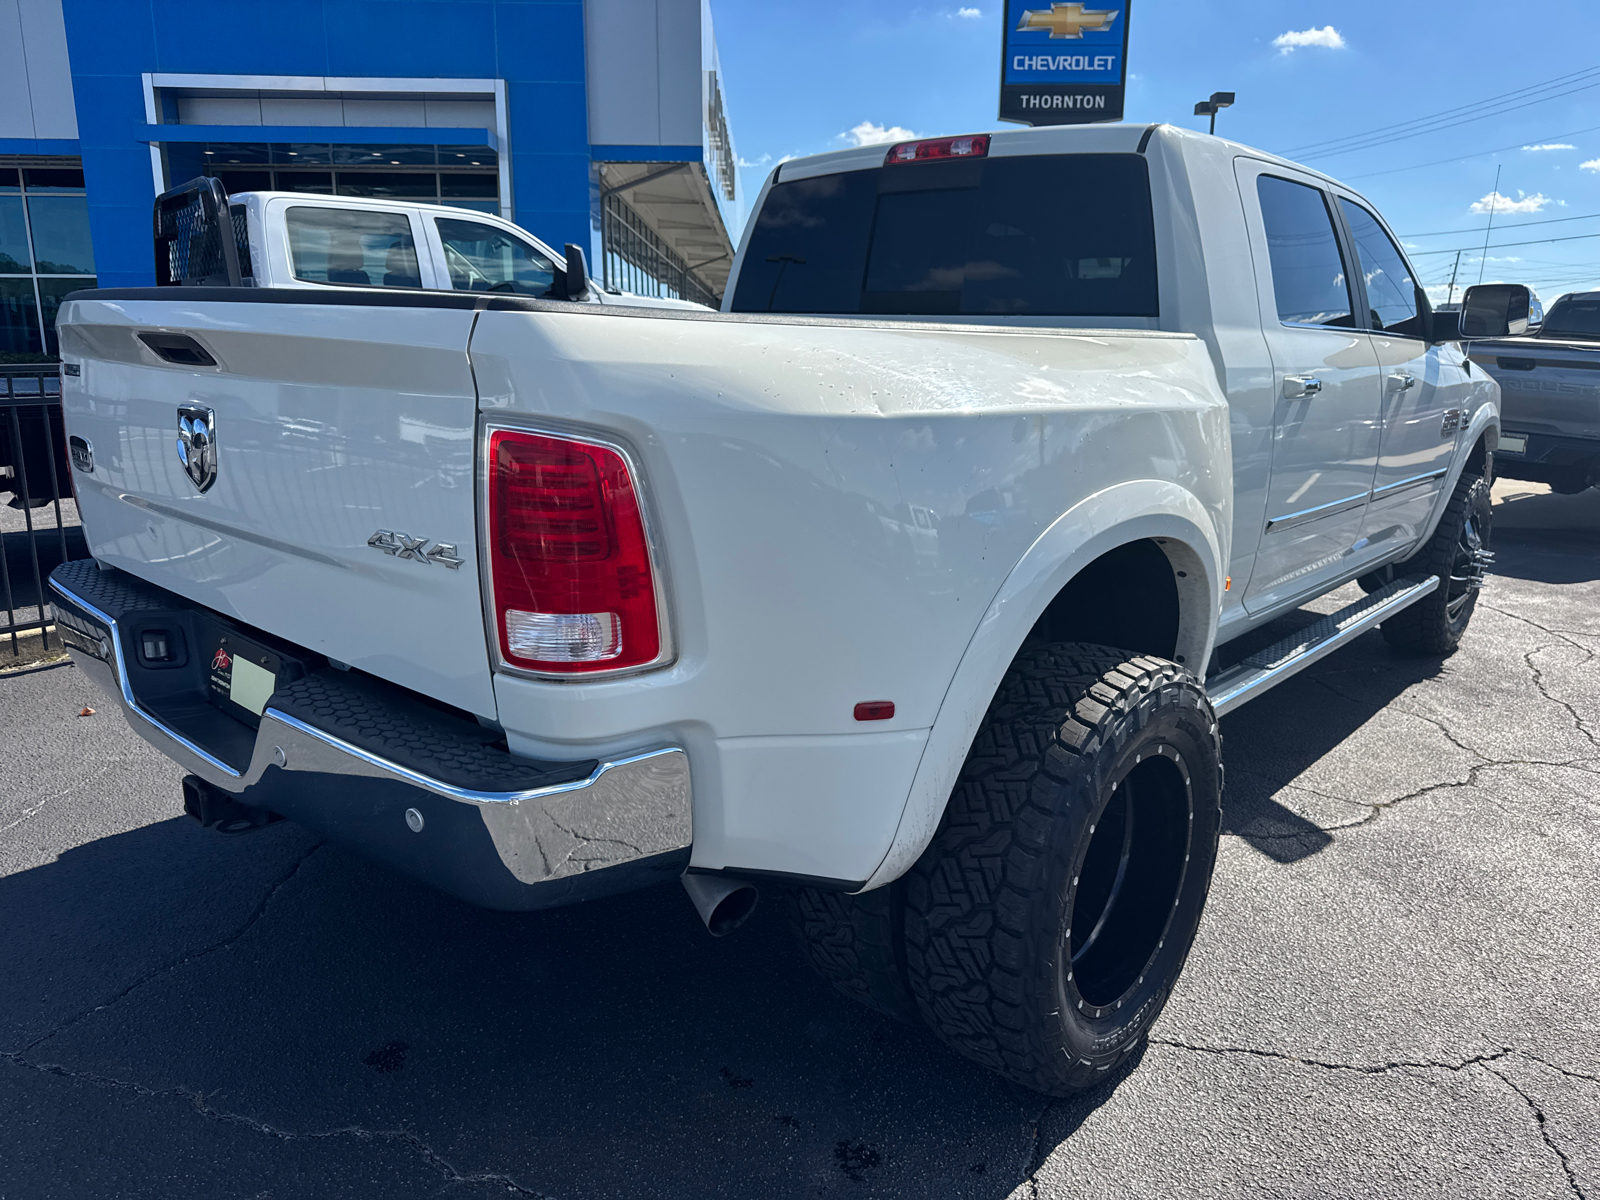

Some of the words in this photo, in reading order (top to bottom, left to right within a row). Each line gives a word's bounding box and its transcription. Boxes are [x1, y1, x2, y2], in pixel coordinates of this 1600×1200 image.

[1013, 55, 1116, 71] CHEVROLET
[1020, 95, 1105, 109] THORNTON
[1501, 377, 1595, 396] ROLET
